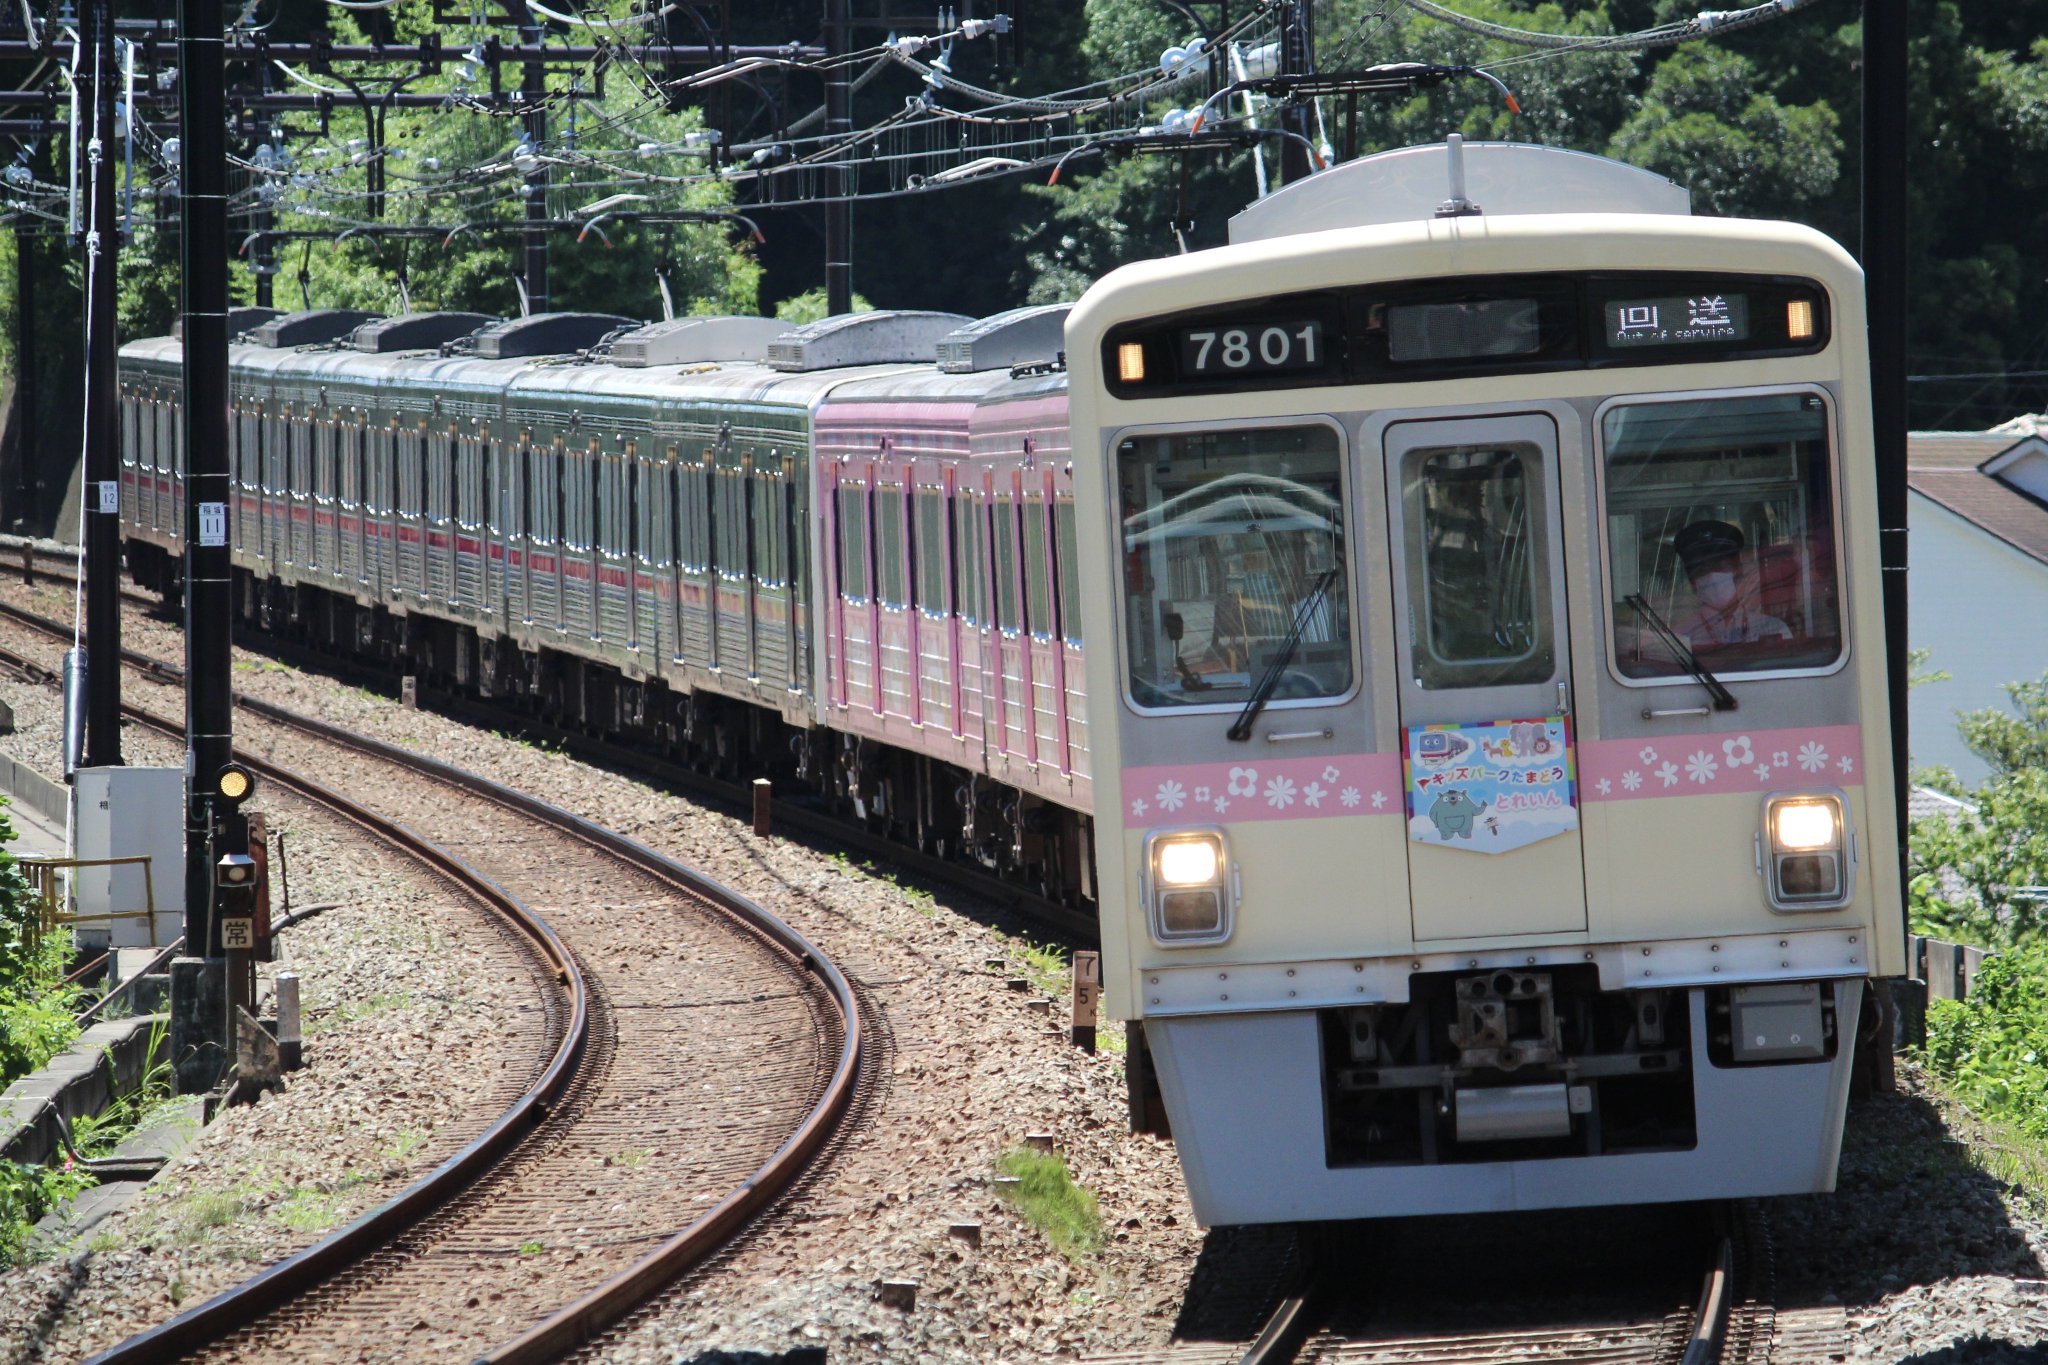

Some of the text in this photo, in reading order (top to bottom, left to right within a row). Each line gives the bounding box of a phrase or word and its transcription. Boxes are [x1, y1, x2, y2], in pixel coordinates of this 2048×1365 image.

[1618, 295, 1731, 331] 回送
[1189, 326, 1316, 369] 7801
[104, 492, 115, 504] 12
[206, 518, 219, 534] 11
[1432, 767, 1564, 785] キッズパークたまどう
[1497, 791, 1560, 810] とれいん
[225, 920, 249, 946] 常
[1079, 987, 1089, 1005] 5
